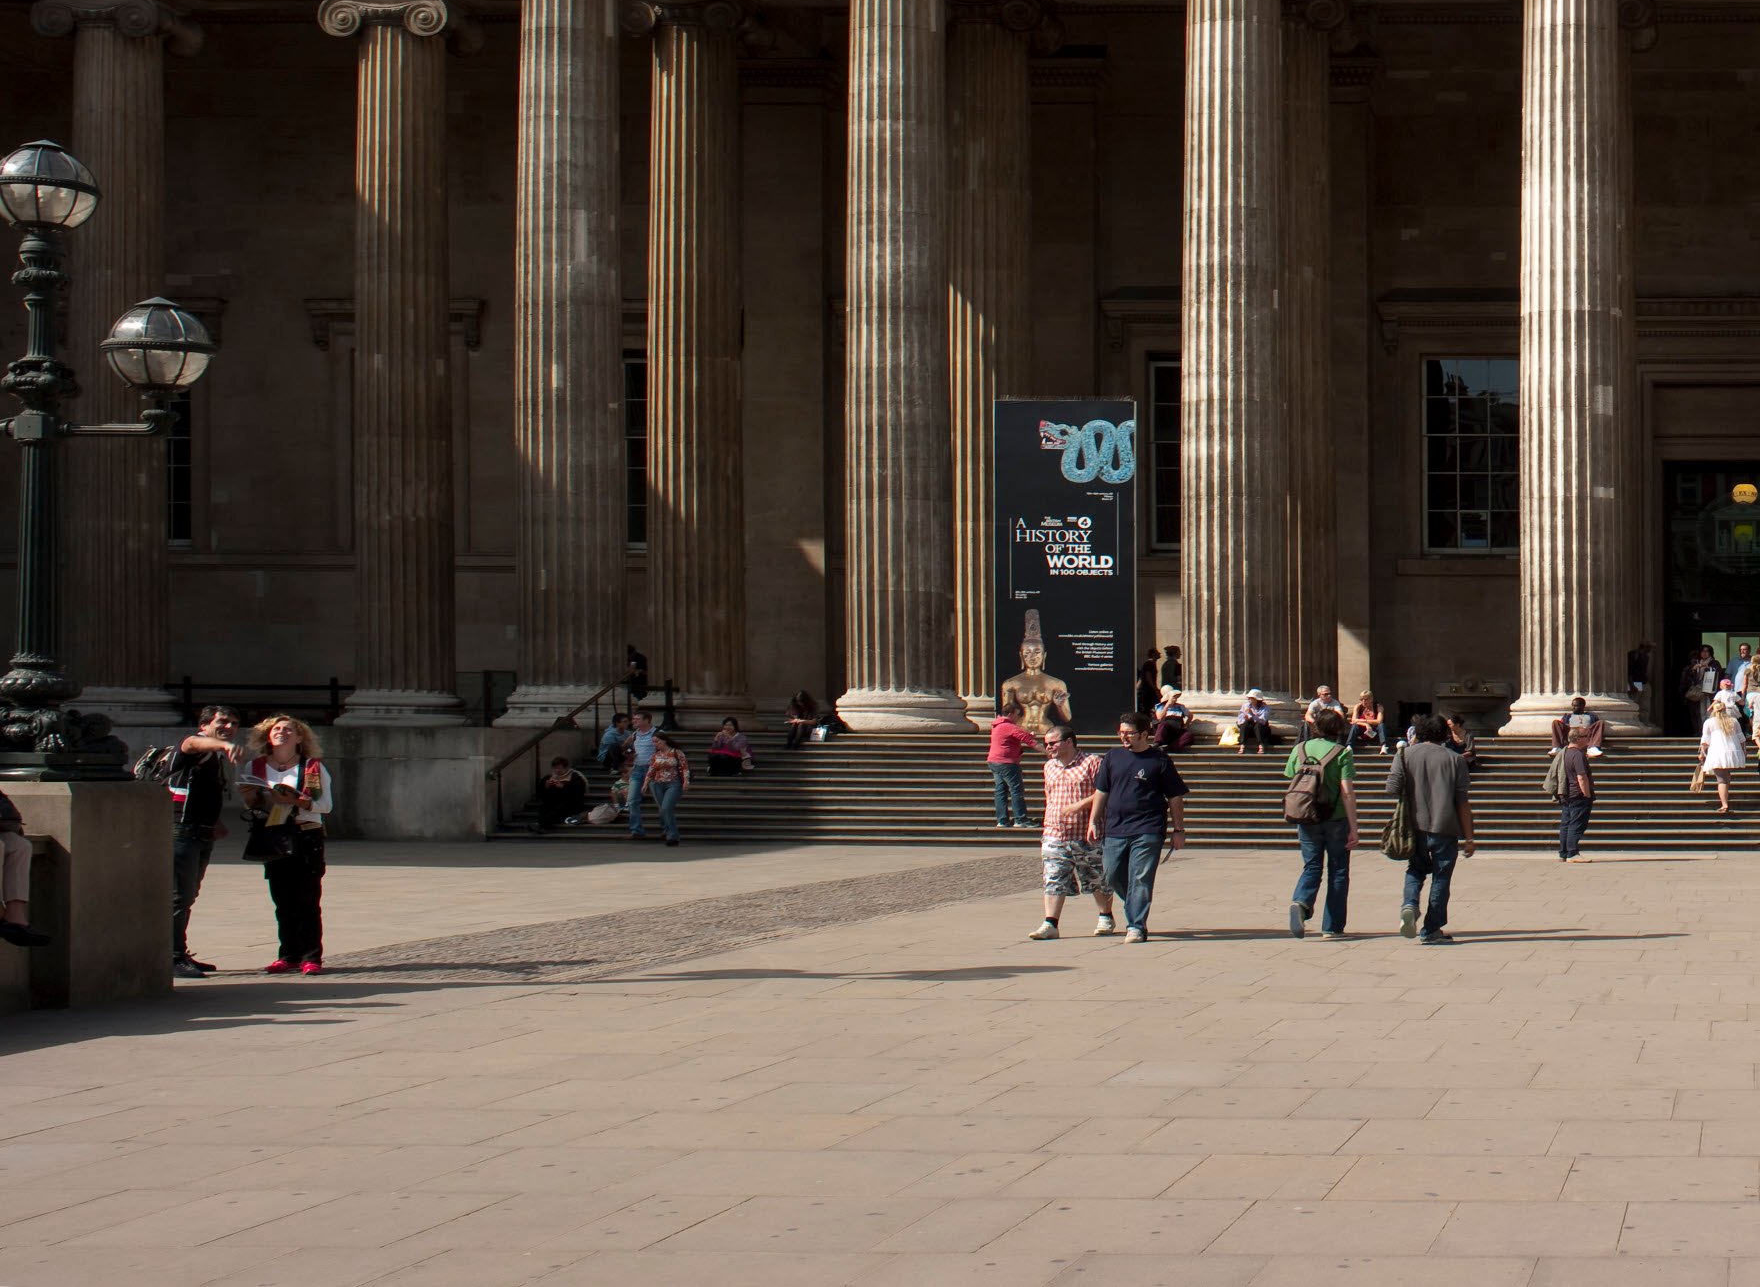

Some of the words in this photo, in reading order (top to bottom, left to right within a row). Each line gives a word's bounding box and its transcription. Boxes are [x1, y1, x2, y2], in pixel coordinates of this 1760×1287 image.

[1016, 517, 1026, 528] A
[1016, 529, 1092, 542] HISTORY
[1045, 544, 1064, 553] OF
[1066, 544, 1091, 553] THE
[1046, 555, 1113, 568] WORLD
